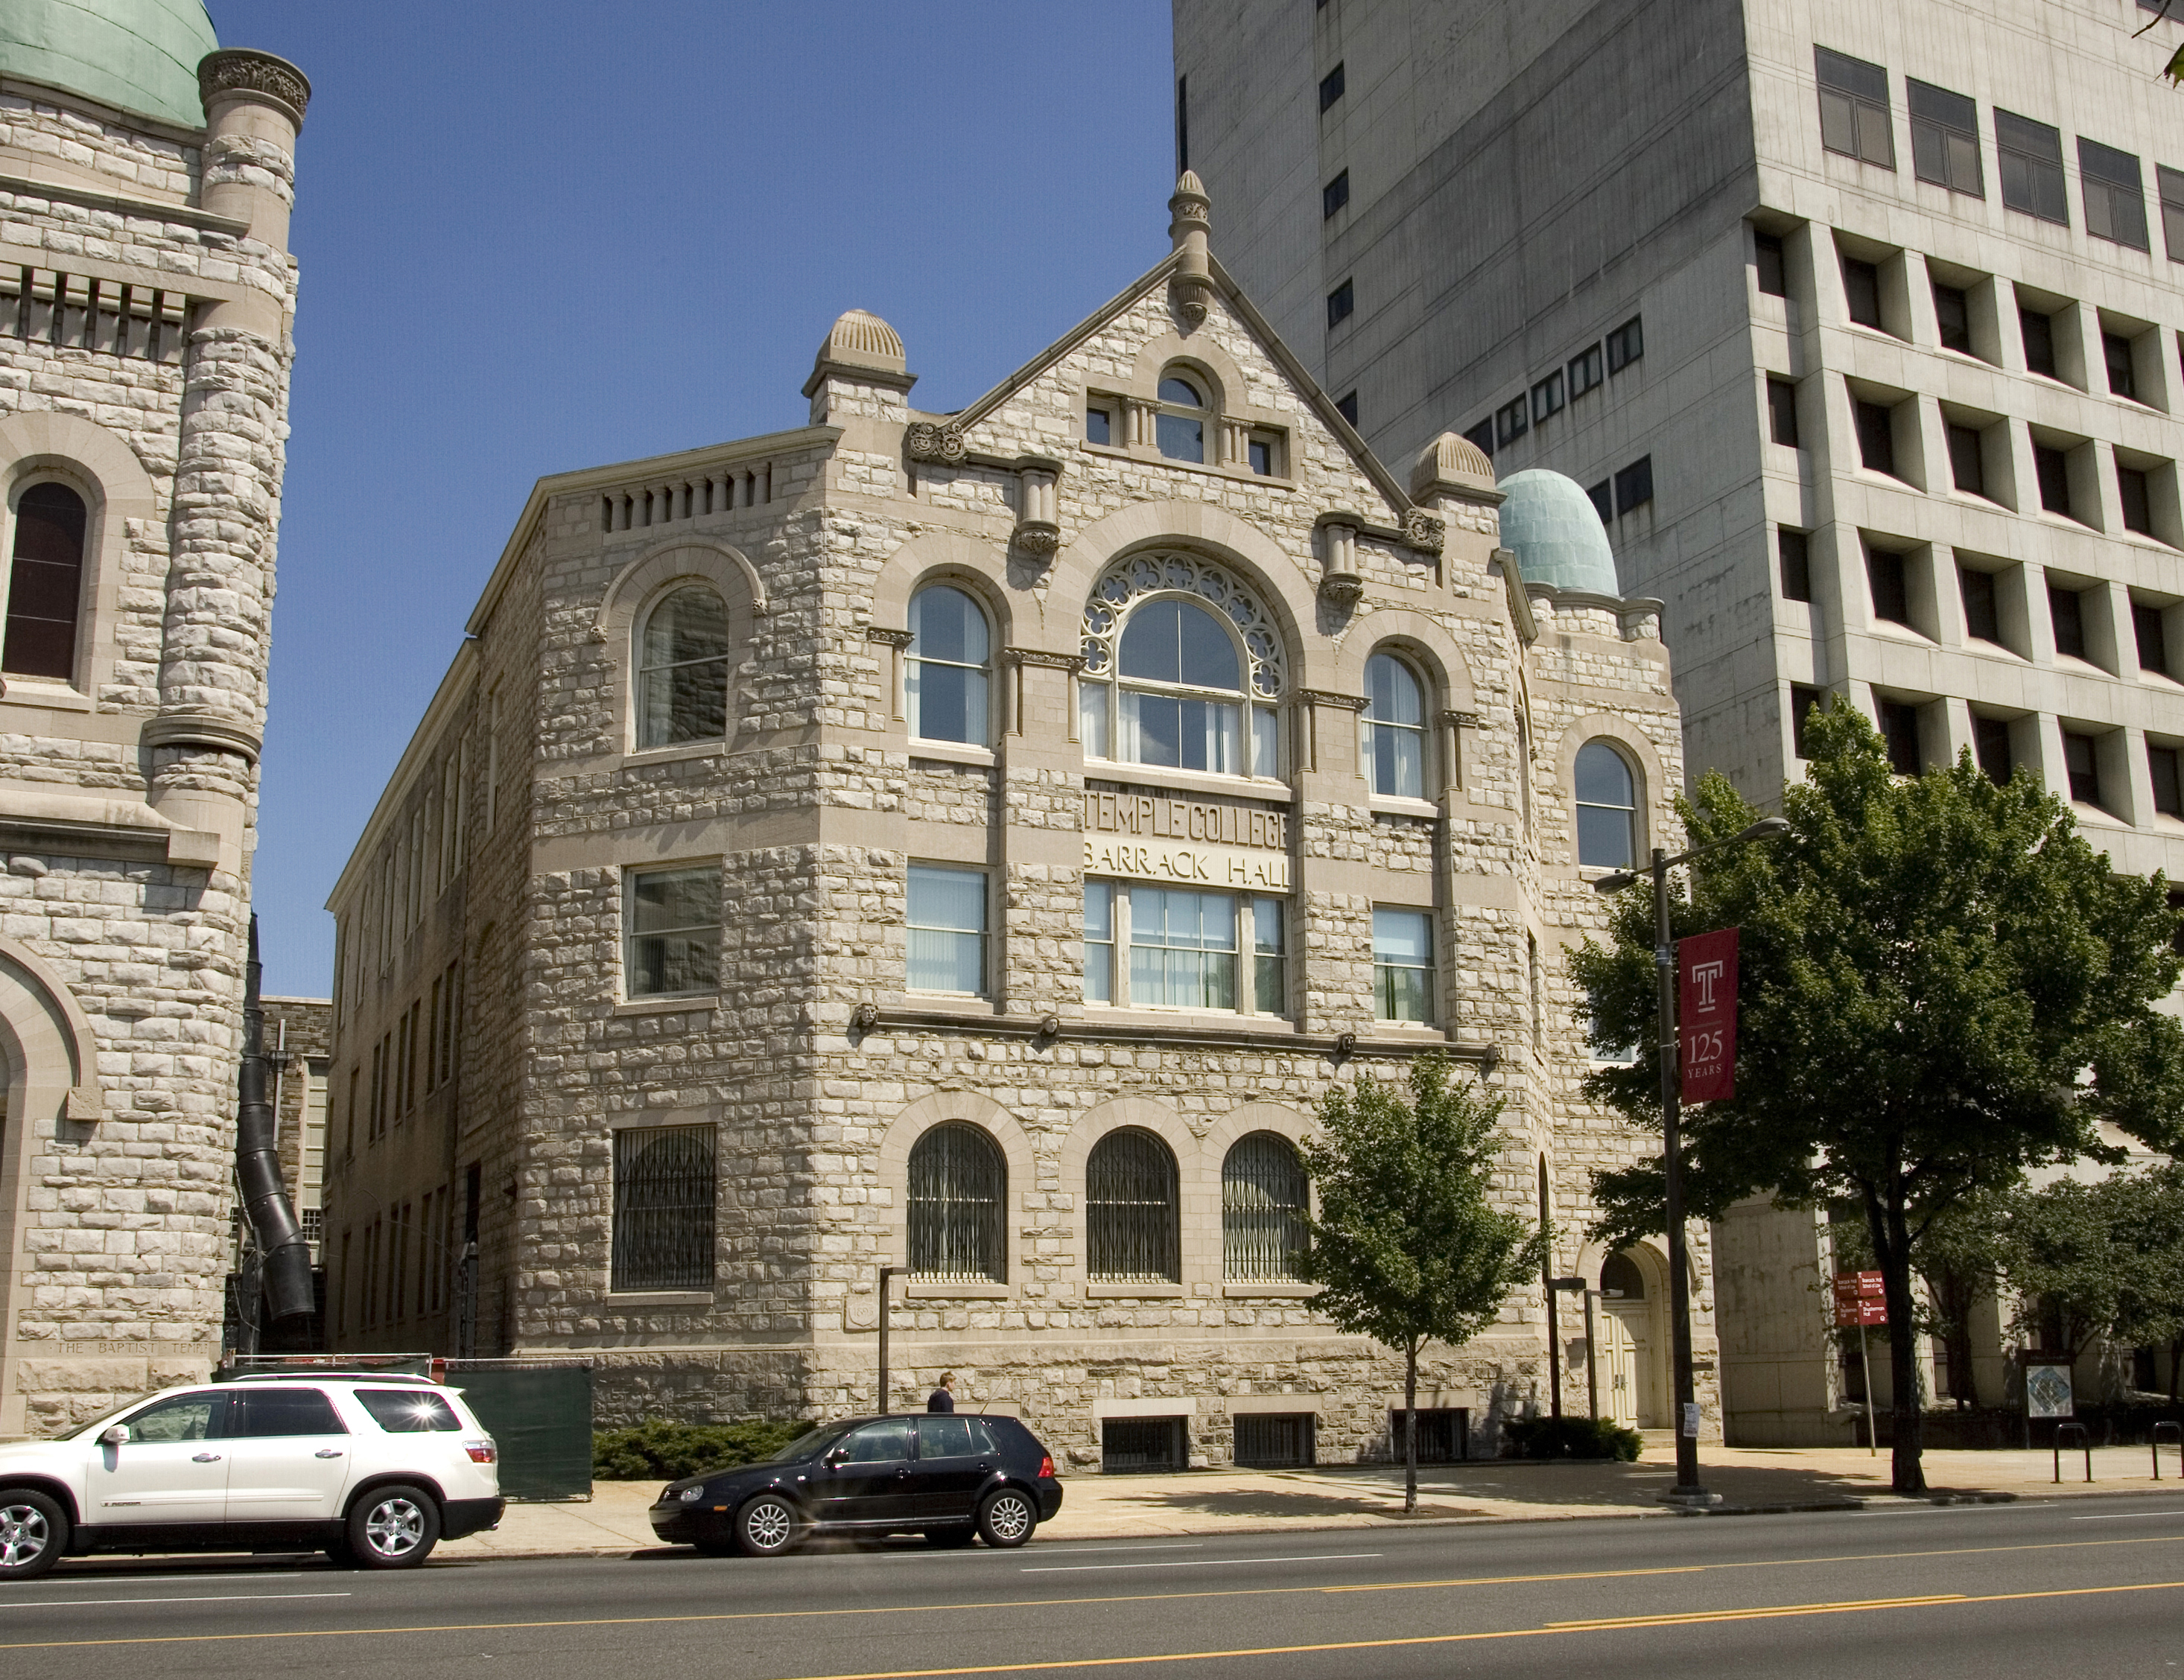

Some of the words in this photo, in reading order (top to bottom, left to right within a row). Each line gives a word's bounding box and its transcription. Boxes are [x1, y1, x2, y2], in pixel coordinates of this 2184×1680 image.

[1084, 790, 1185, 839] TEMPLE
[1190, 803, 1287, 851] COLLEGE
[1084, 842, 1209, 880] BARRACK
[1228, 856, 1290, 888] HALL
[1689, 1029, 1723, 1064] 125
[1688, 1063, 1722, 1079] YEARS
[56, 1343, 83, 1354] THE
[98, 1343, 157, 1354] BAPTIST
